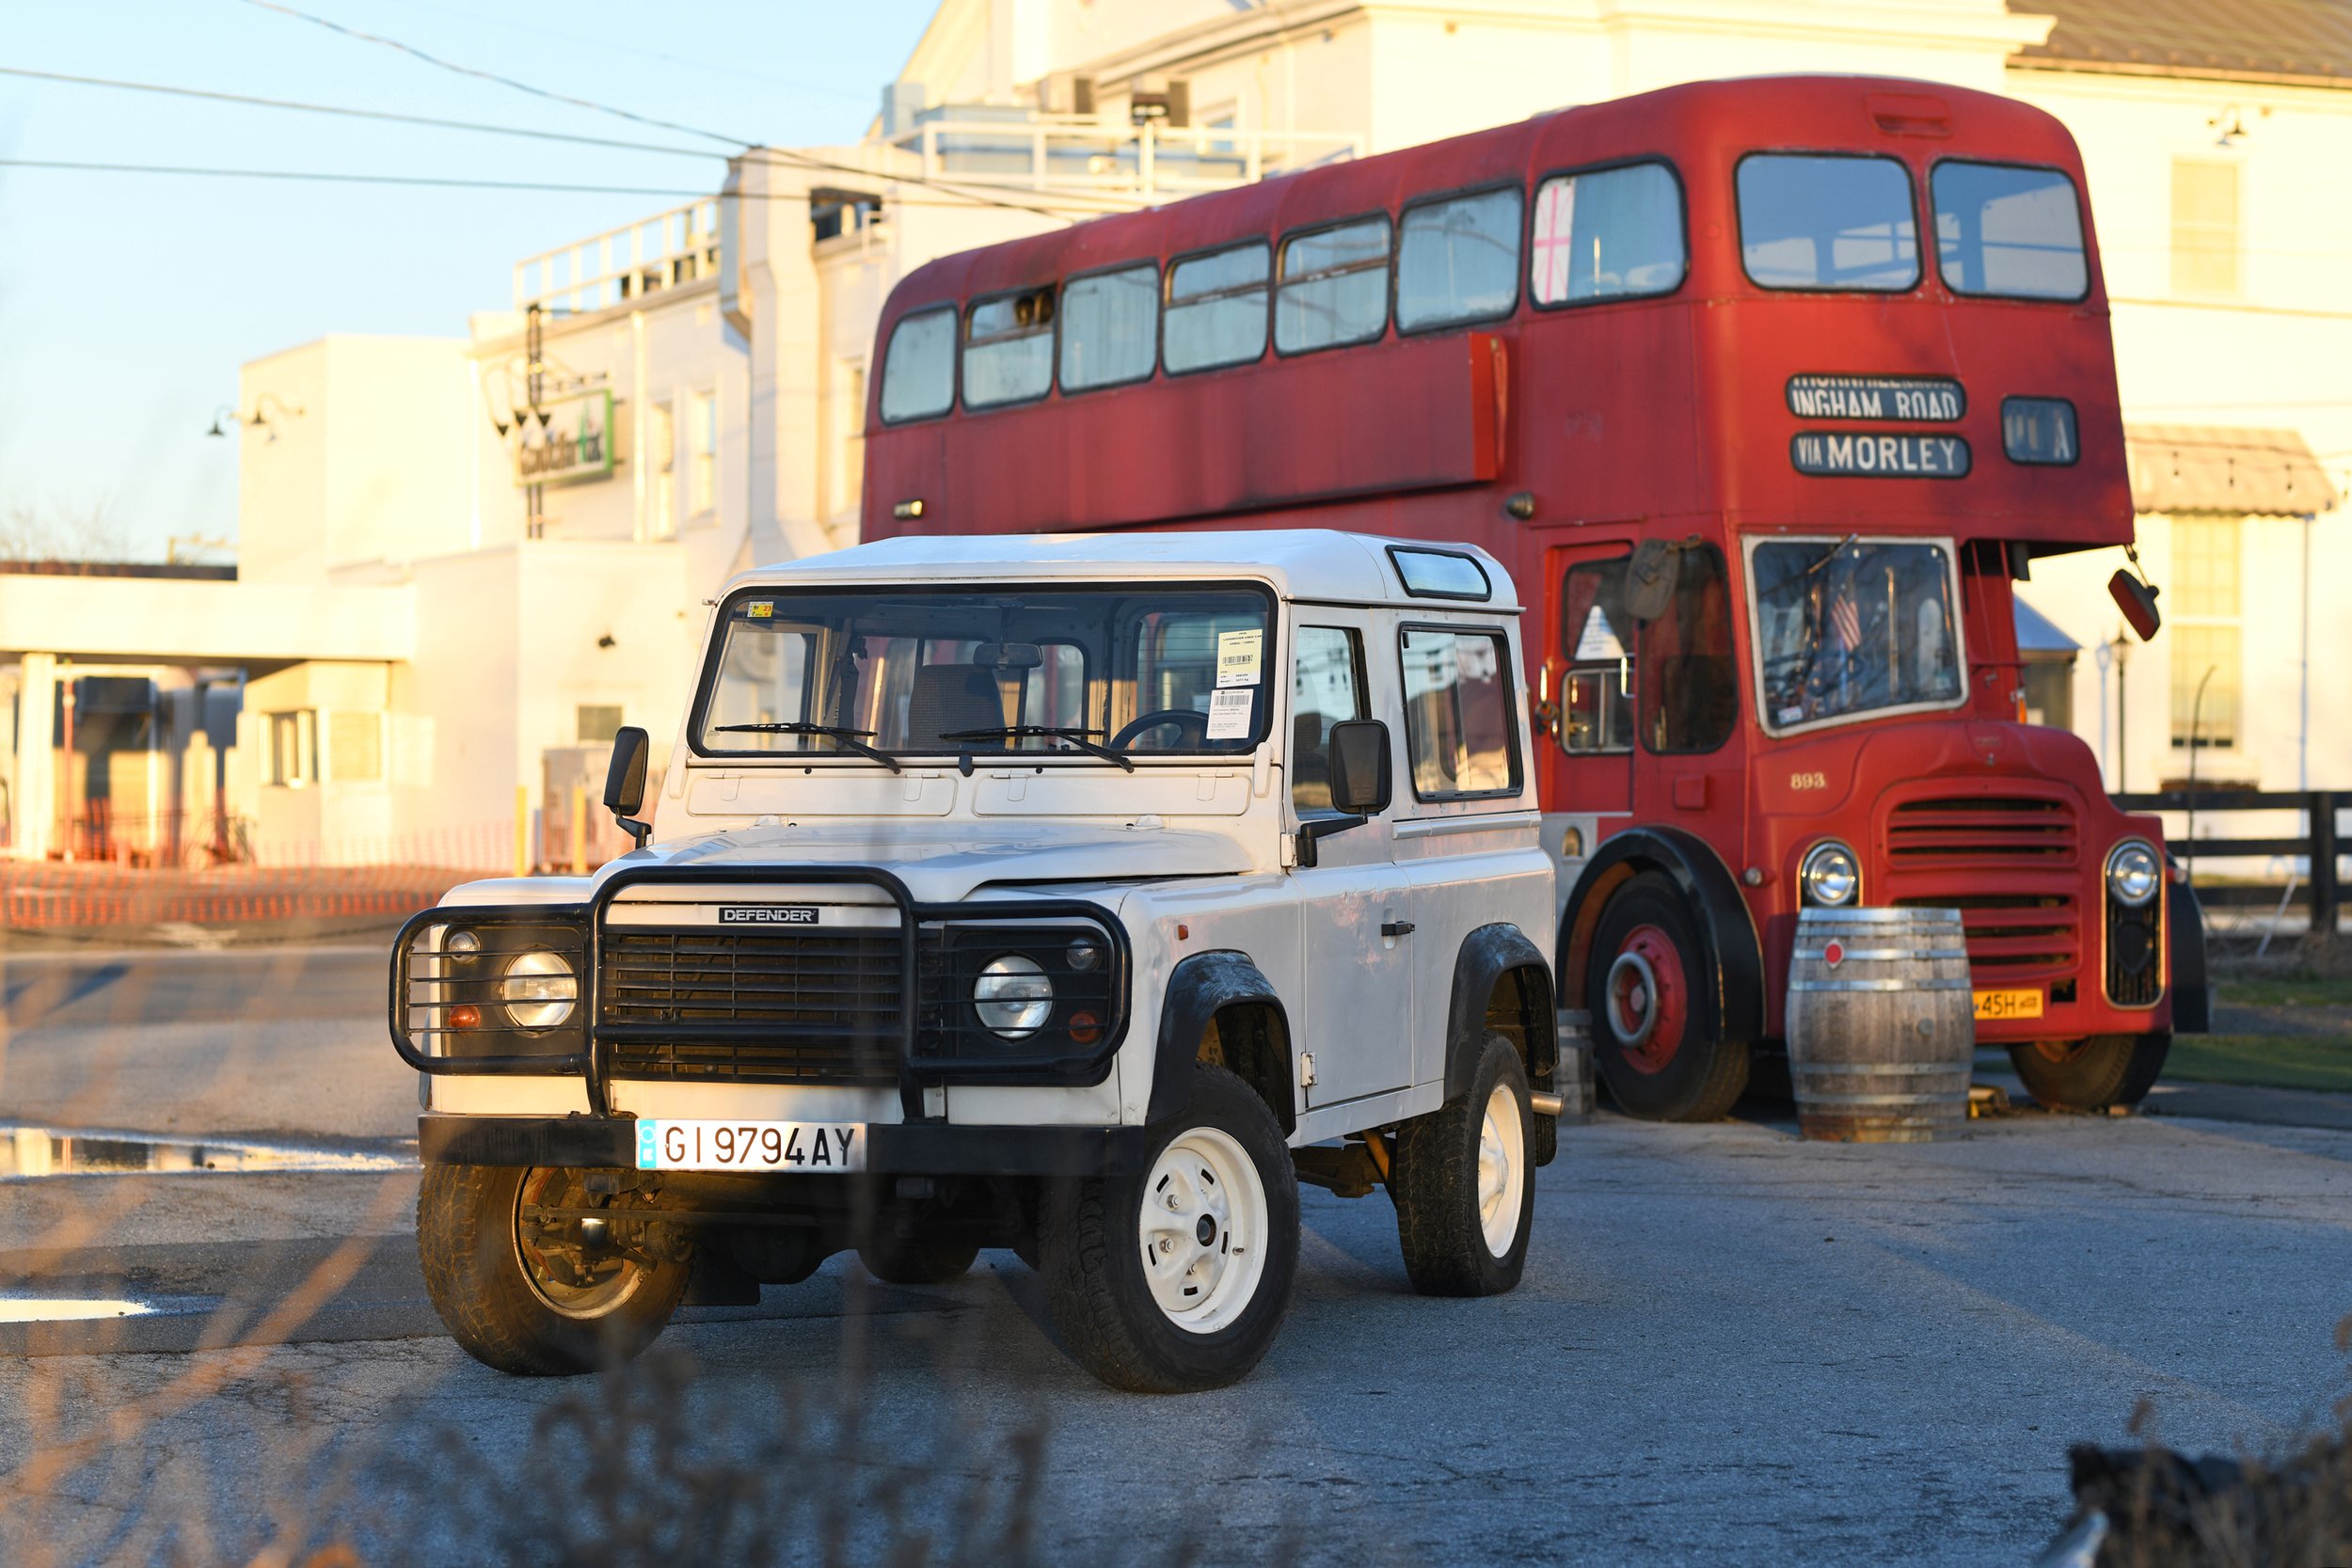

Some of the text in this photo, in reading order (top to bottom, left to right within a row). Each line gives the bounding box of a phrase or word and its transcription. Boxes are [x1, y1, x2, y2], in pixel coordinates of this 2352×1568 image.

[1792, 389, 1882, 418] INGHAM
[1798, 436, 1957, 470] VIA MORLEY
[723, 909, 813, 922] DEFENDER
